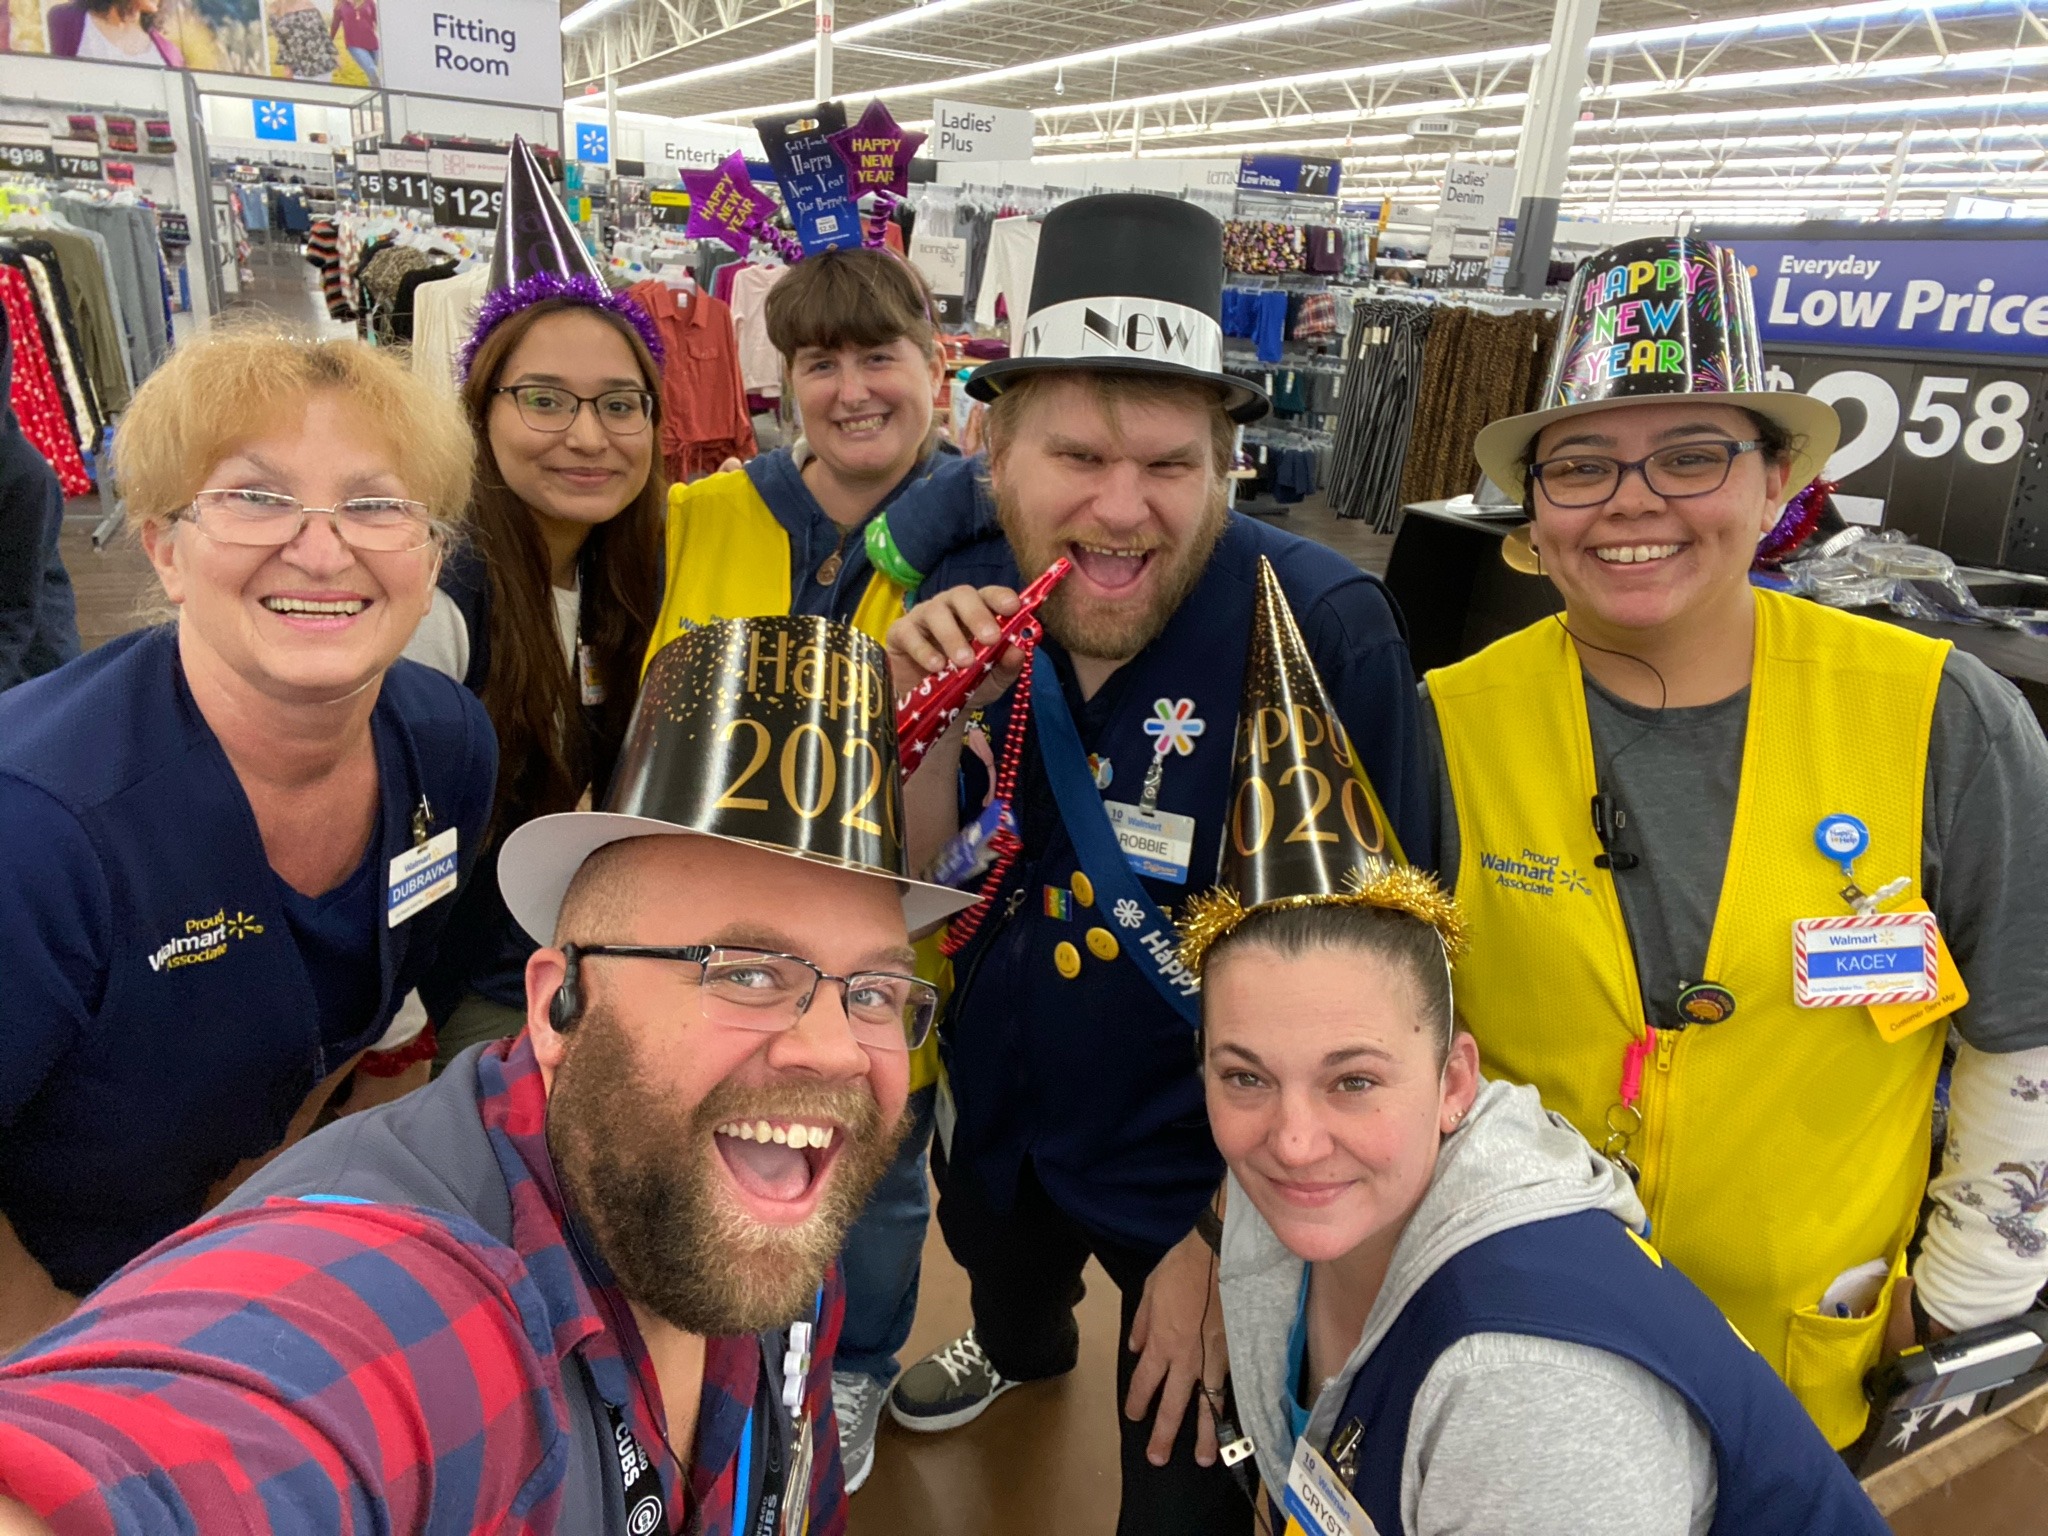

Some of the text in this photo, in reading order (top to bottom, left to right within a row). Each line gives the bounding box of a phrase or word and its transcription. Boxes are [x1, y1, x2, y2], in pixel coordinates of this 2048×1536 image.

[432, 13, 517, 53] Fitting
[435, 45, 510, 77] Room
[852, 138, 901, 152] HAPPY
[941, 131, 973, 153] Plus
[791, 154, 832, 175] Happy
[861, 154, 893, 168] NEW
[788, 174, 845, 199] New Year
[857, 170, 895, 184] YEAR
[1241, 174, 1281, 187] Low Price
[1300, 164, 1331, 187] $797
[388, 177, 428, 200] $11
[699, 172, 734, 221] HAPPY
[1447, 187, 1485, 205] Denim
[653, 206, 667, 219] $7
[717, 188, 743, 222] NEW
[726, 198, 756, 233] YEAR
[1780, 255, 1881, 279] Everyday
[1583, 259, 1704, 312] HAPPY
[1769, 277, 2048, 336] Low Price
[1592, 299, 1685, 345] NEW
[1585, 339, 1686, 385] YEAR
[747, 631, 893, 745] Happ
[1232, 764, 1385, 857] 020
[1128, 817, 1162, 831] Walmart
[1120, 833, 1168, 855] ROBBIE
[1480, 851, 1555, 883] Walmart
[1522, 849, 1560, 867] Proud
[393, 858, 453, 902] DUBRAVKA
[1496, 874, 1554, 897] Associate
[185, 908, 225, 934] Proud
[1830, 933, 1877, 946] Walmart
[1140, 930, 1201, 997] Happy
[1836, 953, 1897, 972] KACEY
[1890, 1010, 1924, 1031] Customer
[616, 1422, 640, 1487] CUBS
[1304, 1452, 1351, 1522] 10 Walmart
